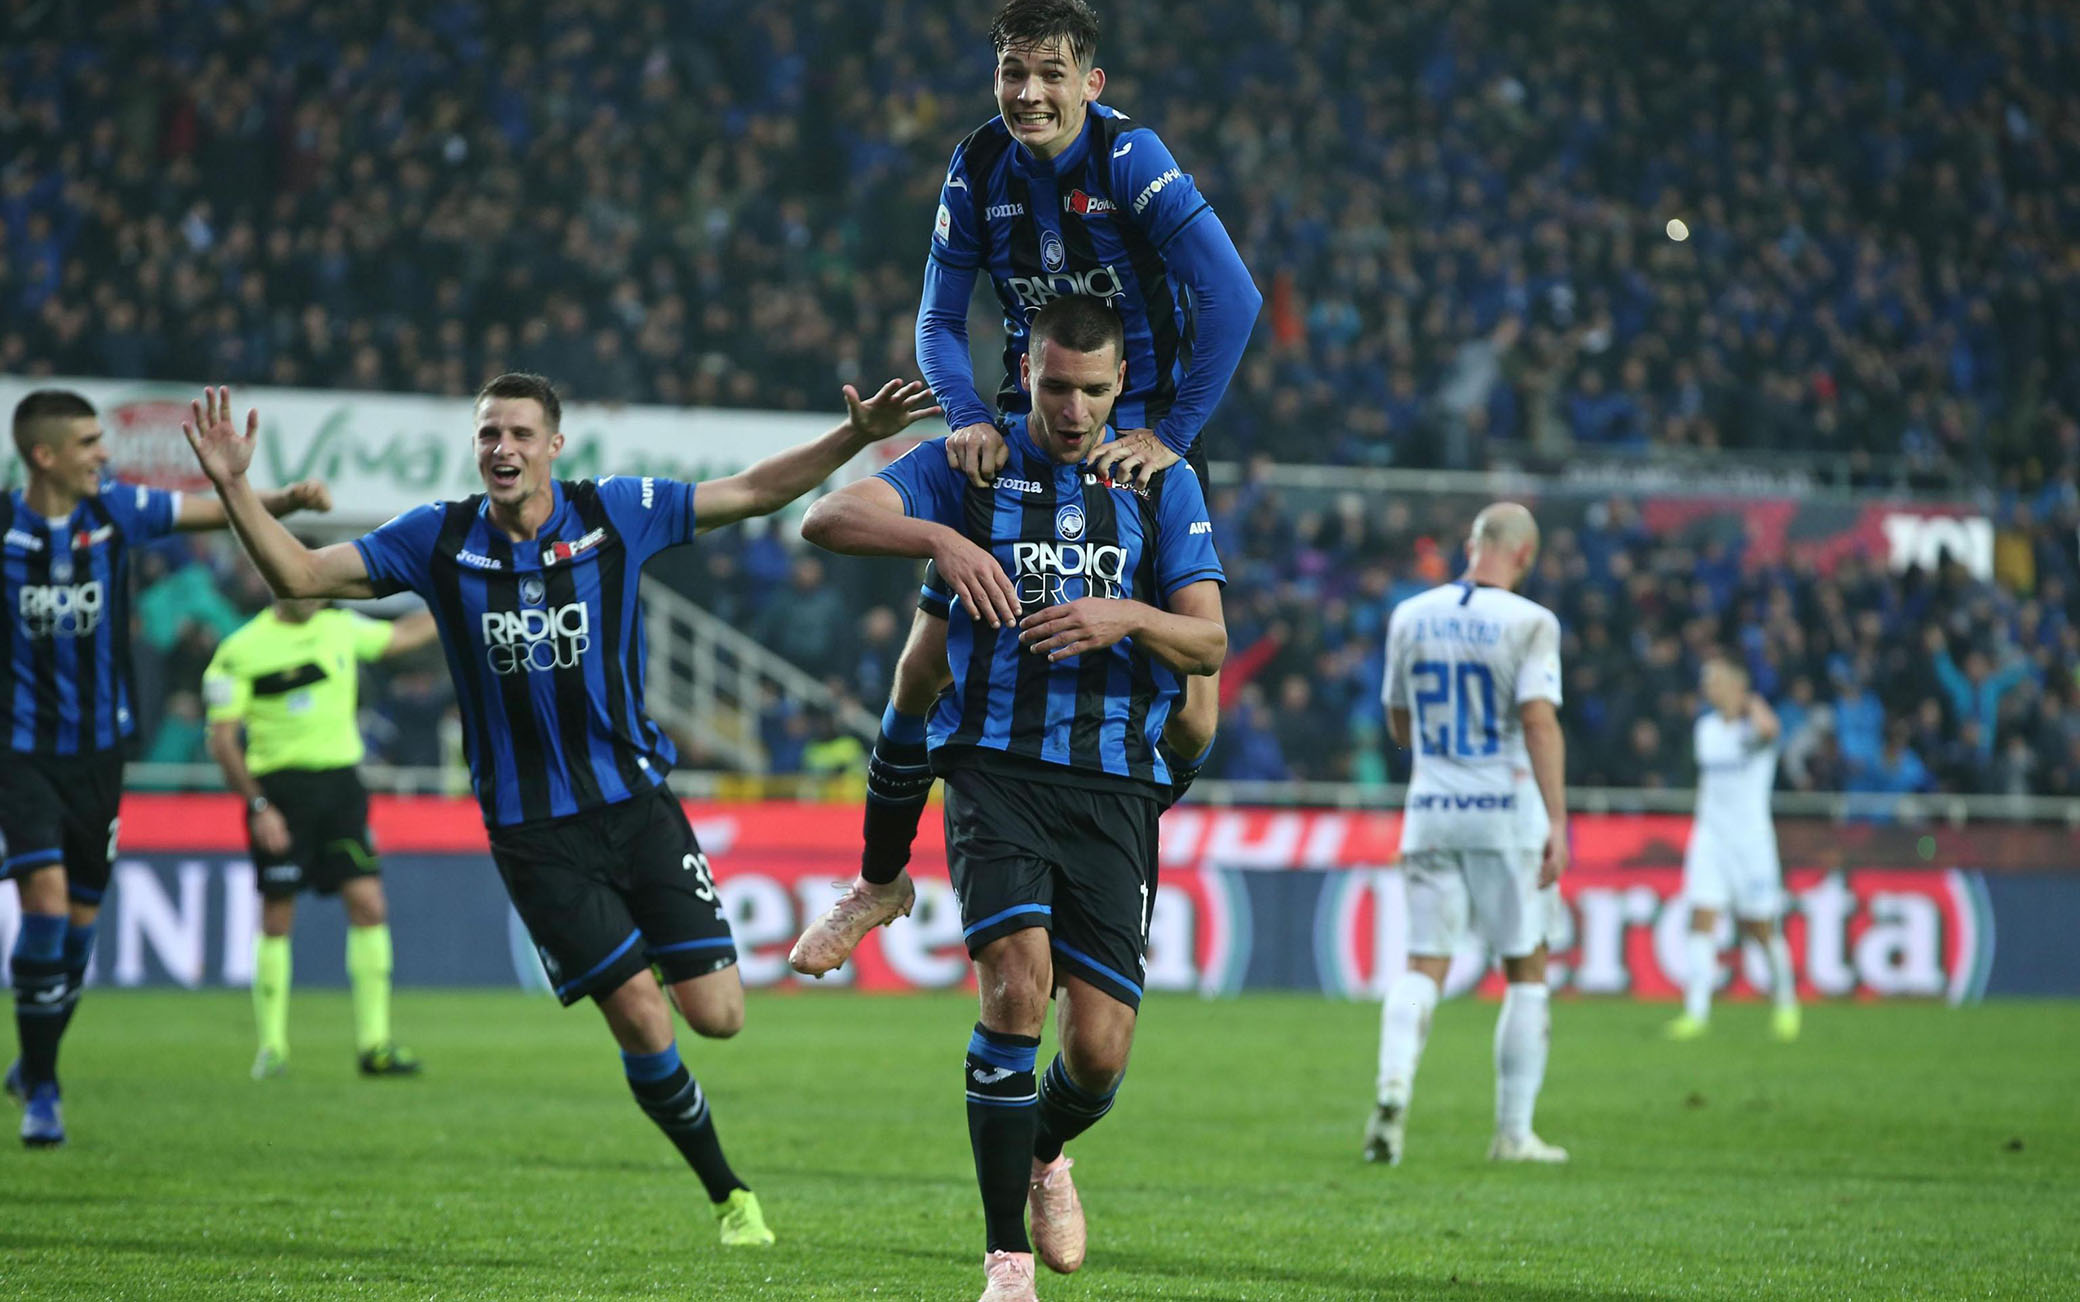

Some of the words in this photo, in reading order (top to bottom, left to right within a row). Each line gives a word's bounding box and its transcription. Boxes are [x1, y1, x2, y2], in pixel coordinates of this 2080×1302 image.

[985, 202, 1024, 222] Joma
[1008, 265, 1123, 306] RADICI
[993, 477, 1043, 494] Joma
[456, 549, 502, 570] Joma
[1013, 541, 1128, 584] RADICI
[481, 602, 589, 646] RADICI
[487, 635, 590, 674] GROUP
[1411, 661, 1500, 757] 20
